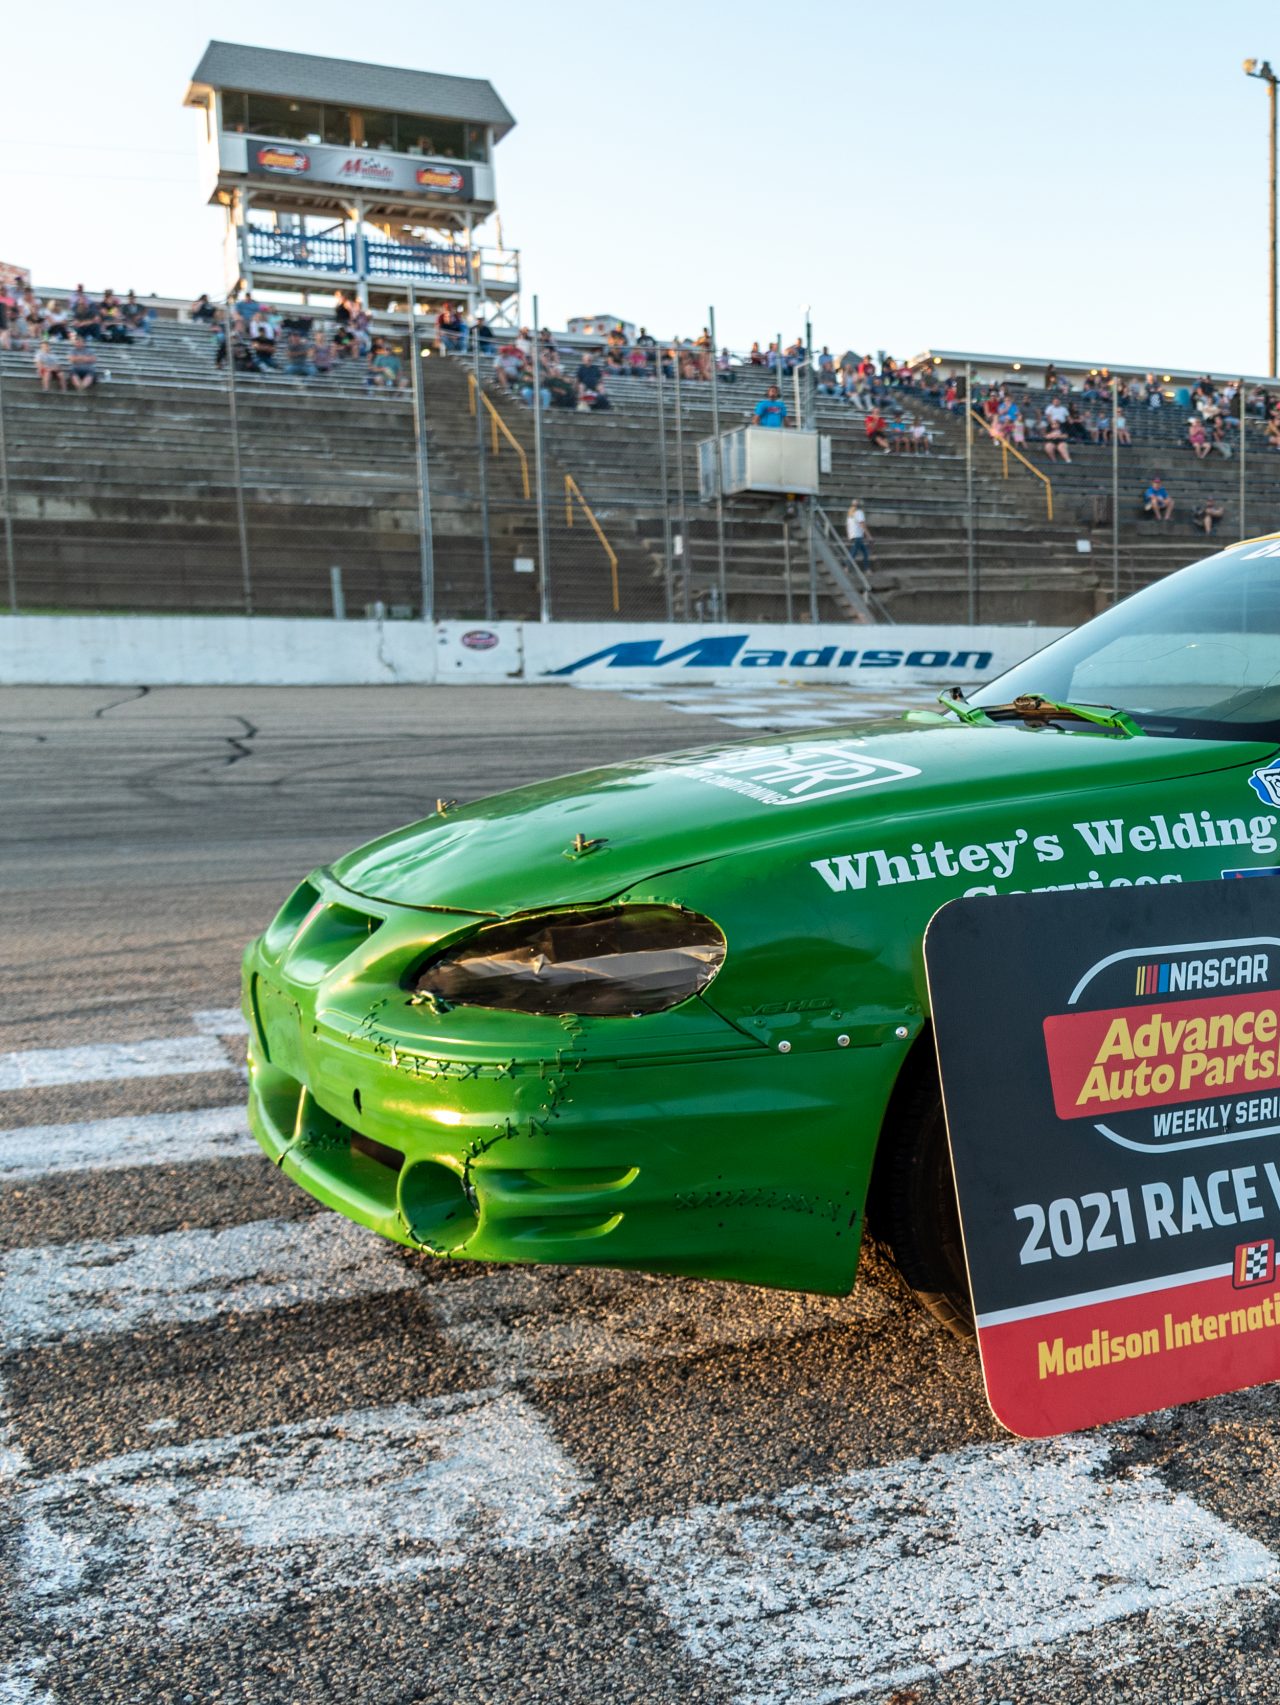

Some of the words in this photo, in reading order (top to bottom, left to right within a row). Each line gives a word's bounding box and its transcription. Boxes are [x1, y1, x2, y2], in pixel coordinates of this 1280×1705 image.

[540, 634, 994, 675] Madison
[811, 828, 1064, 893] Whitey's
[1073, 811, 1278, 855] Welding
[1169, 954, 1269, 993] NASCAR
[1094, 1009, 1278, 1065] Advance
[1075, 1059, 1175, 1106] Auto
[1179, 1044, 1276, 1091] Parts
[1153, 1103, 1232, 1138] WEEKLY
[1013, 1187, 1136, 1265] 2021
[1141, 1164, 1264, 1241] RACE
[1038, 1327, 1160, 1380] Madison
